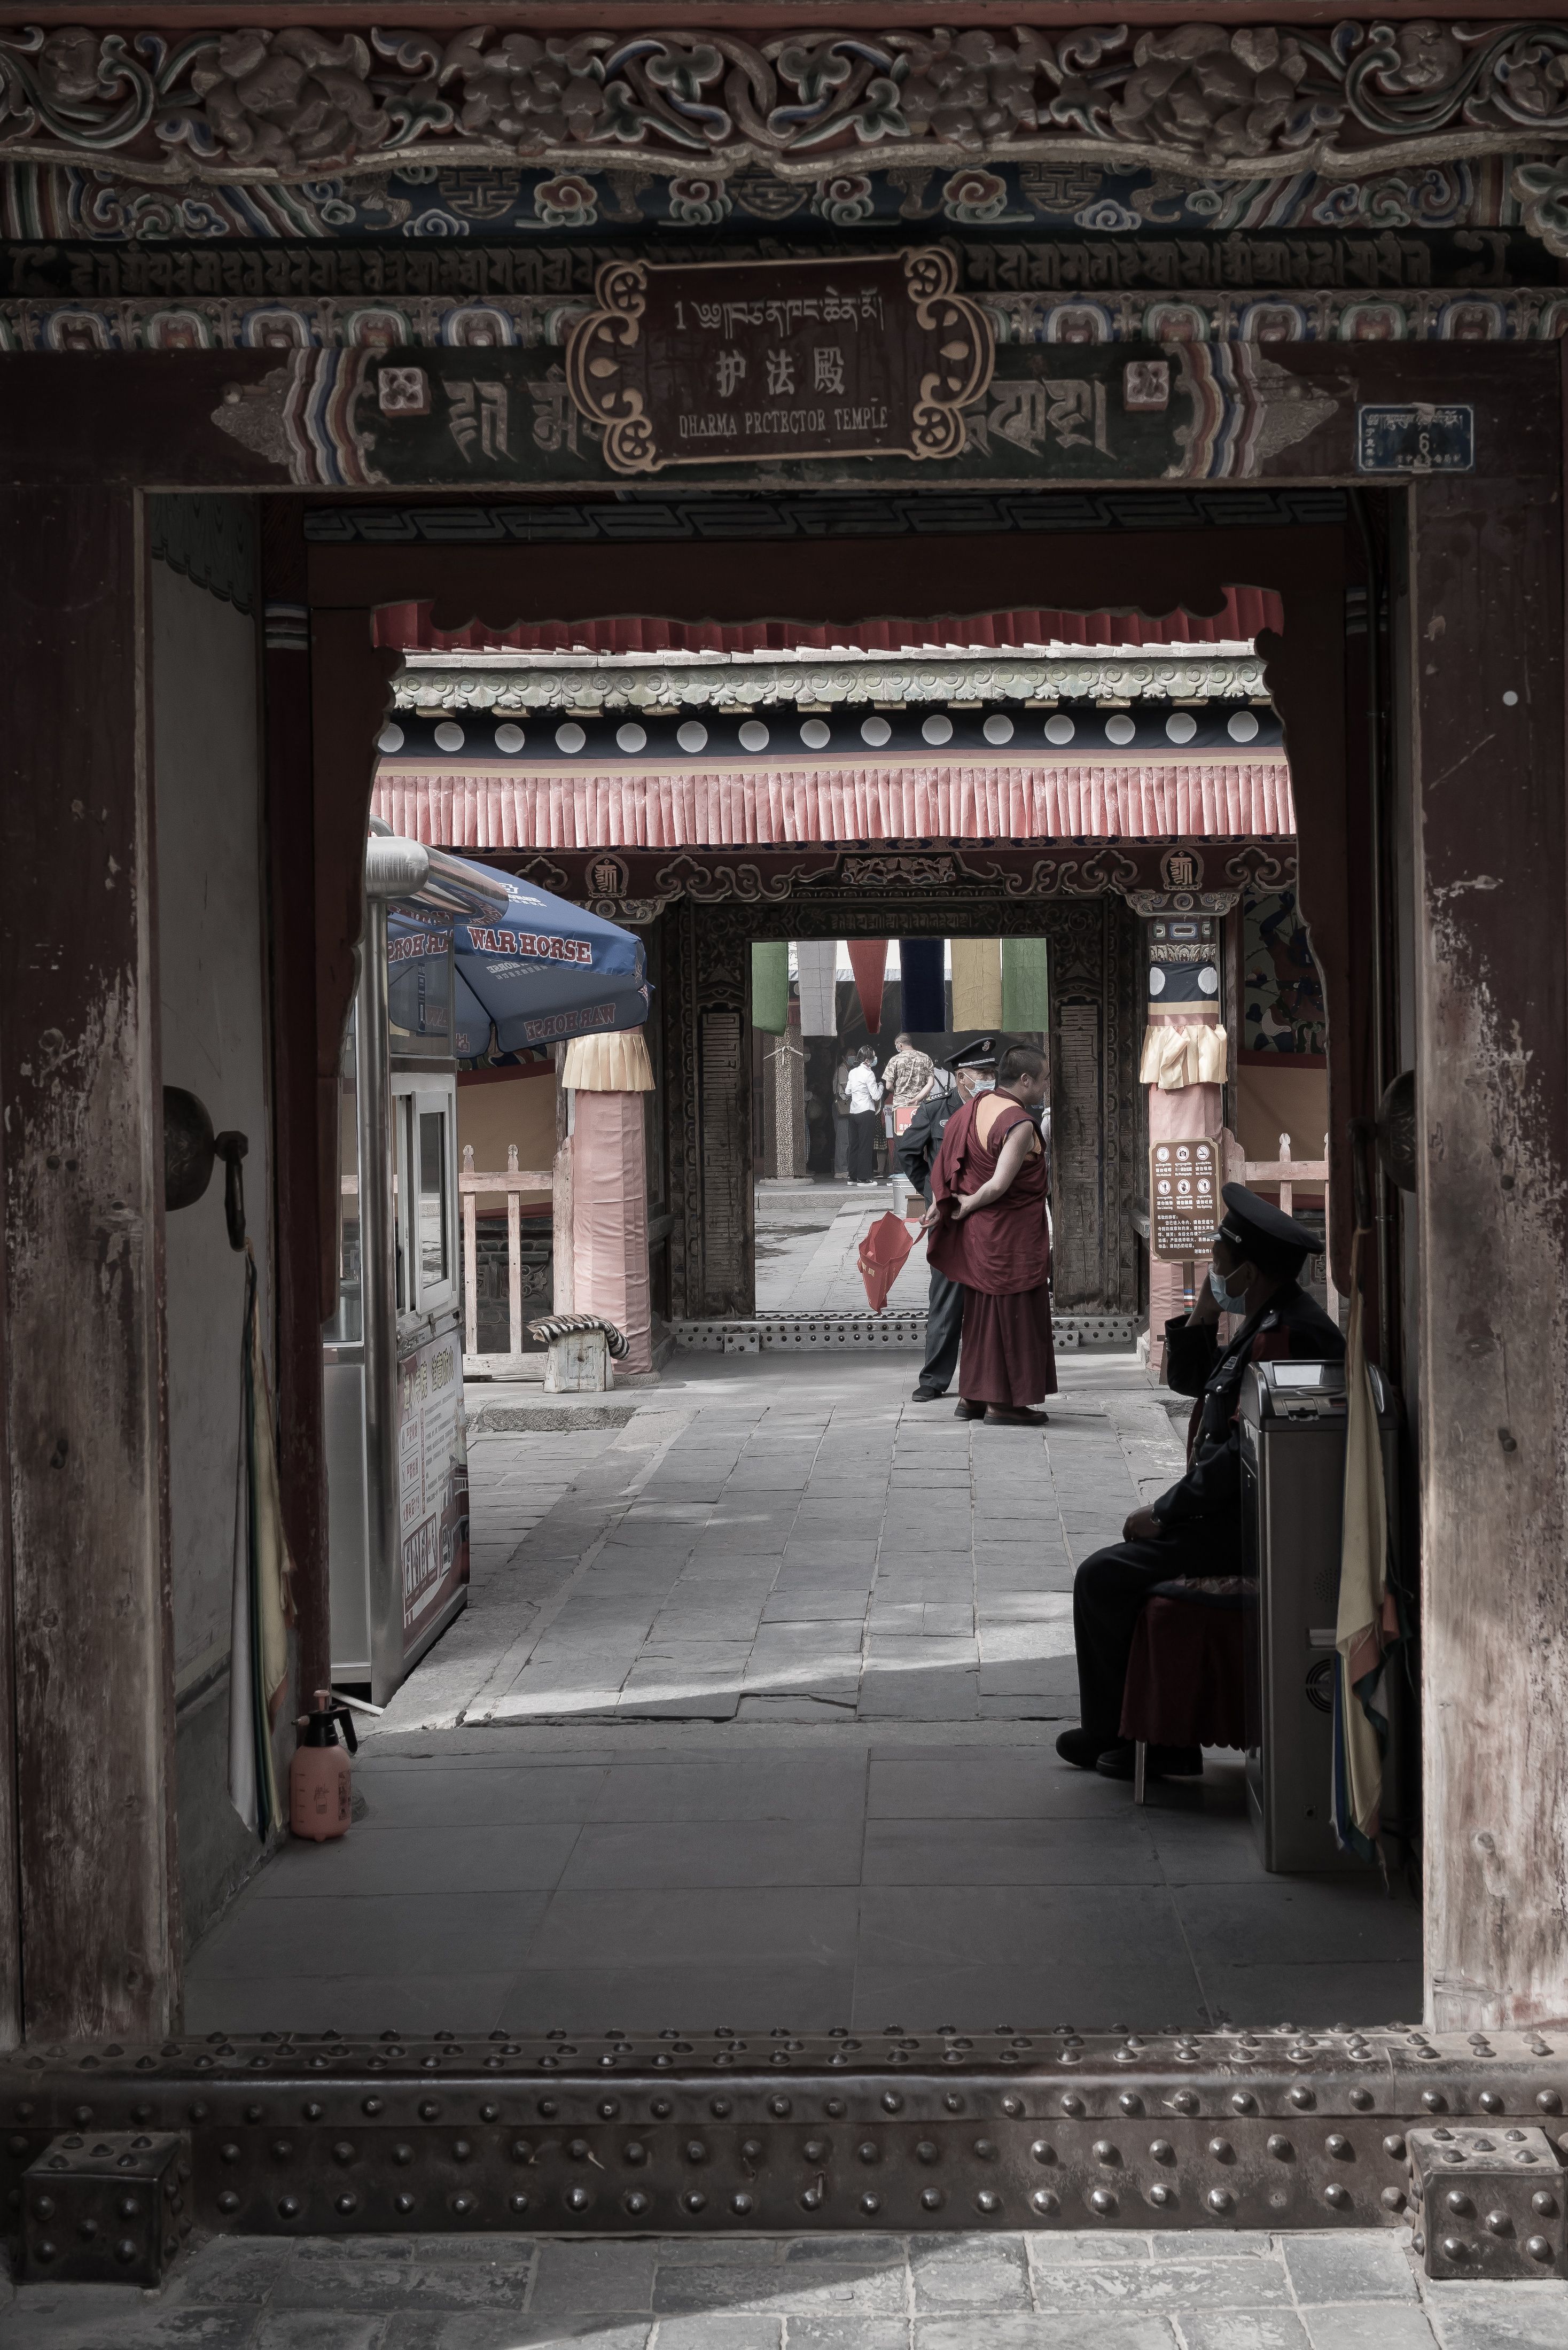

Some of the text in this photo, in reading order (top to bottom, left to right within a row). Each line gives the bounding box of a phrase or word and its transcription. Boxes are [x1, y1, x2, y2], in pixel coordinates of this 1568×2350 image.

[716, 346, 846, 398] 护法殿
[678, 414, 738, 438] DHARMA
[834, 406, 888, 431] TEMPLE
[466, 926, 593, 964] WAR HORSE
